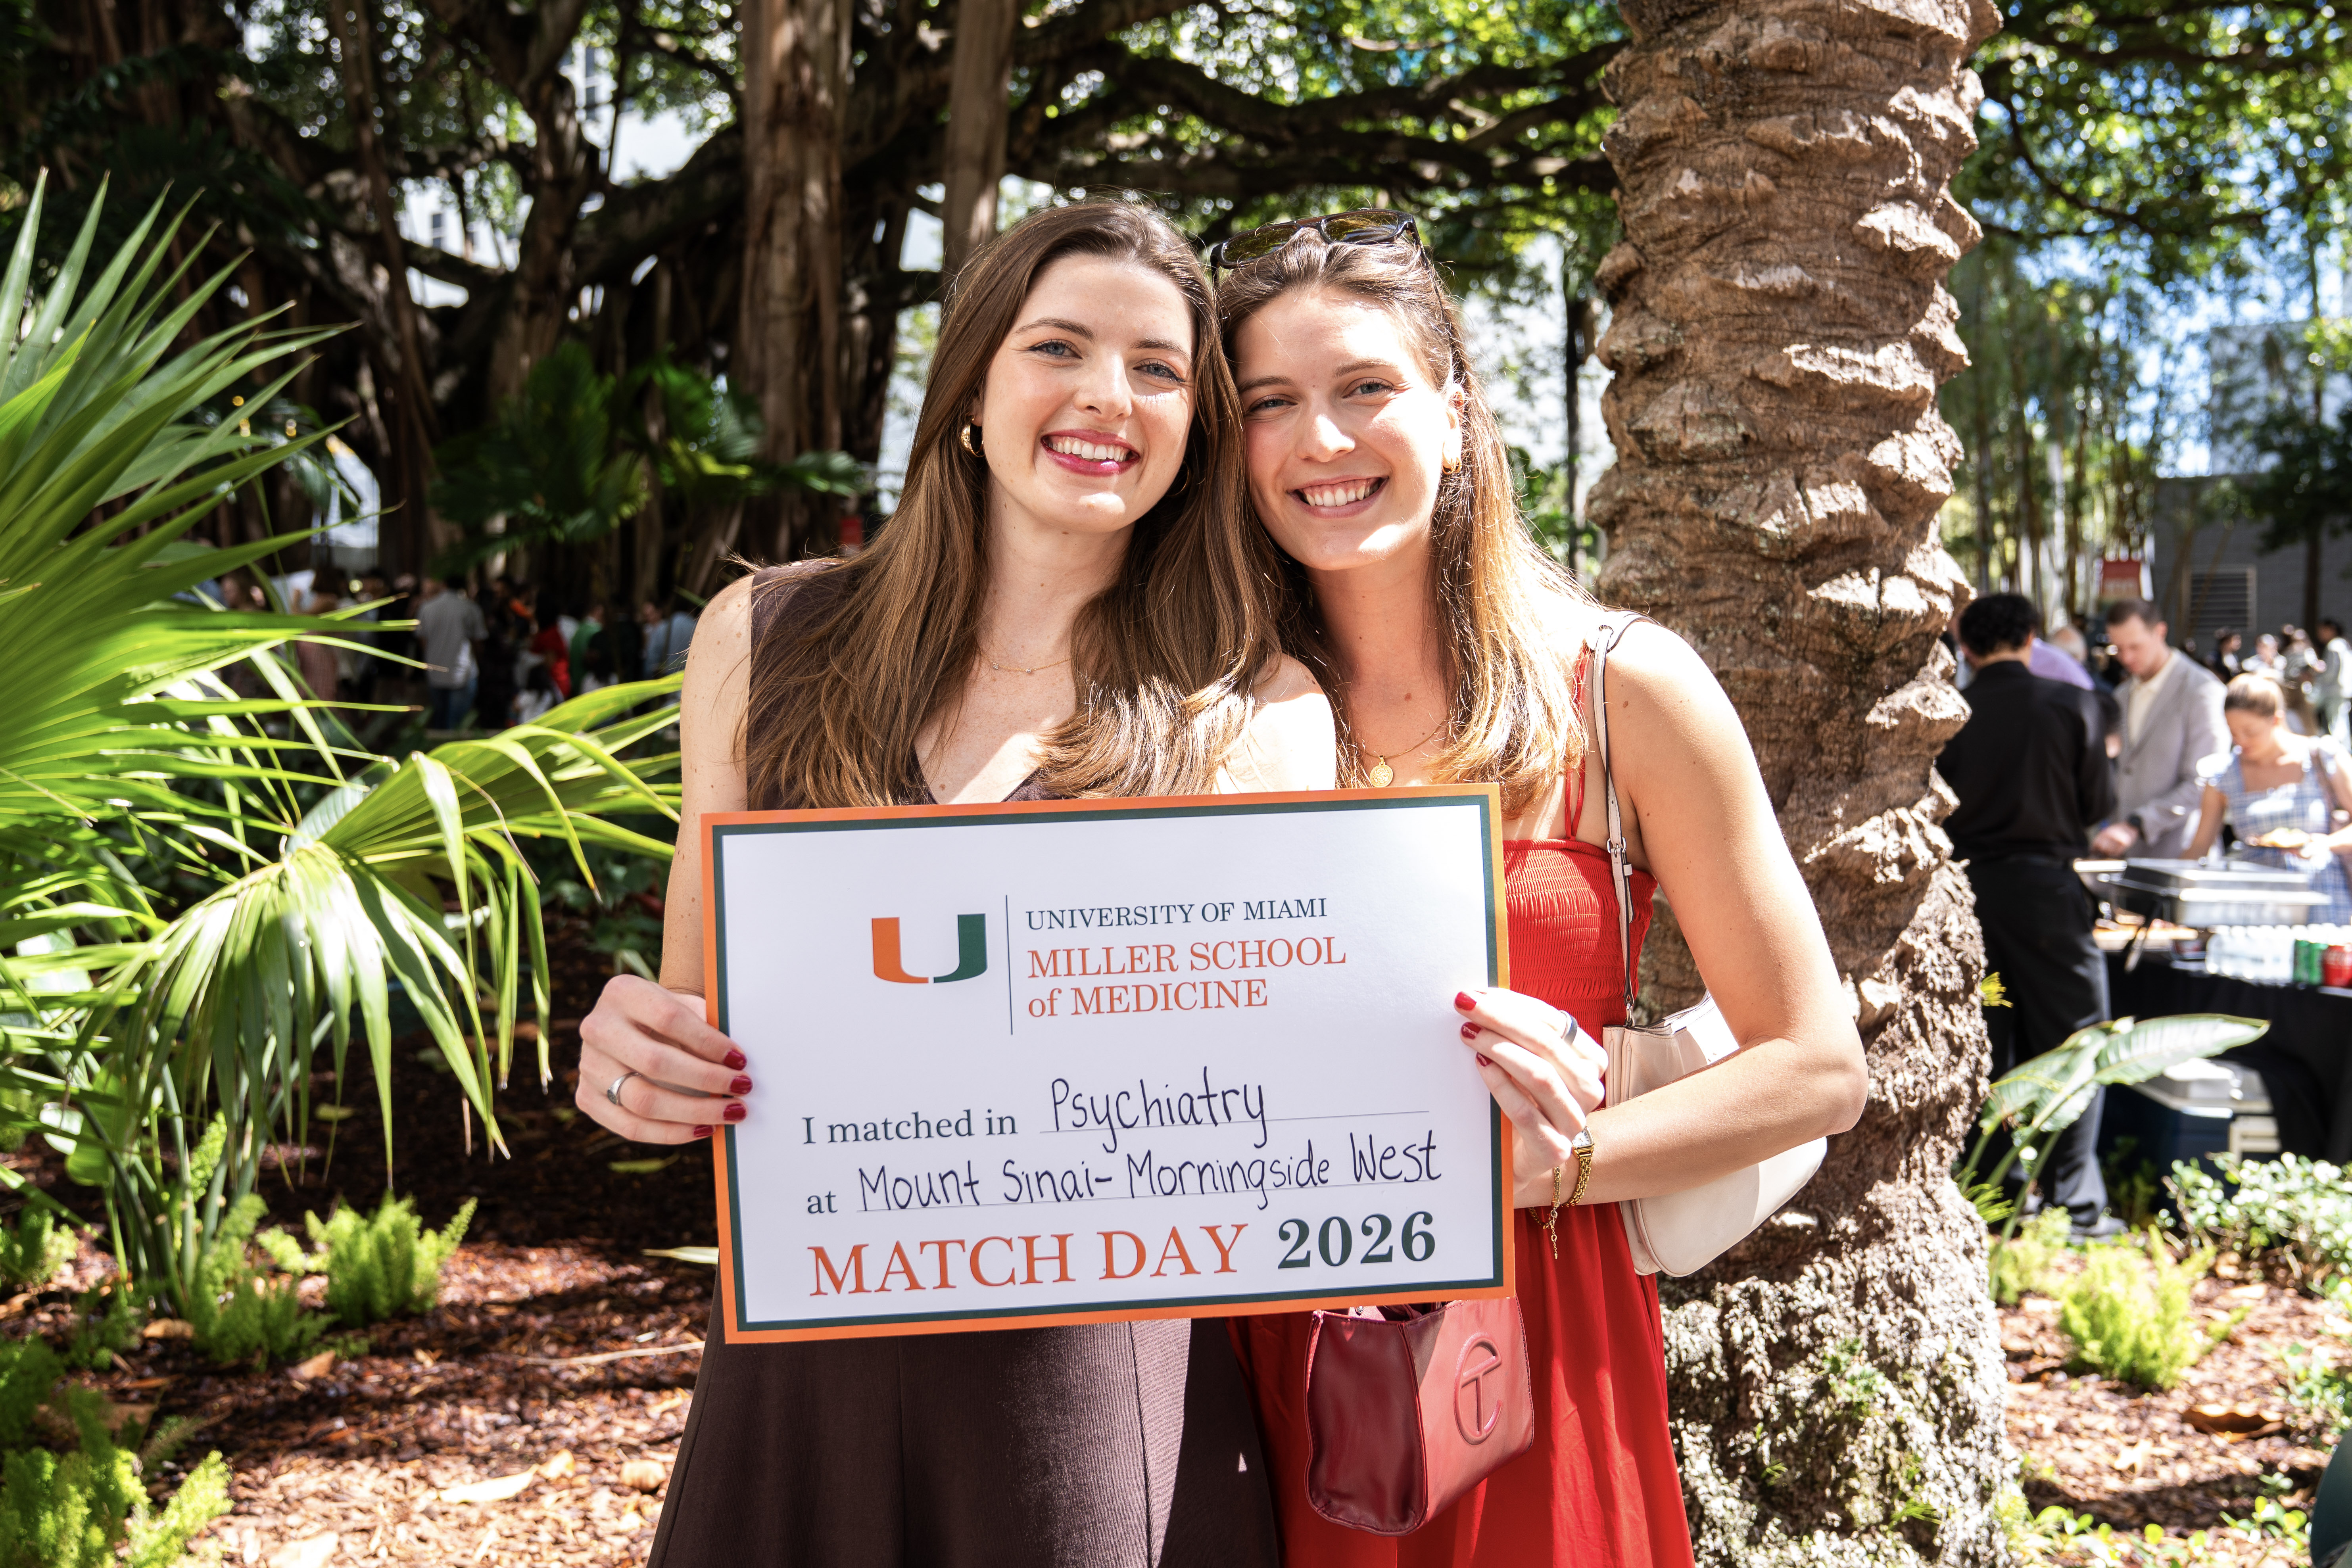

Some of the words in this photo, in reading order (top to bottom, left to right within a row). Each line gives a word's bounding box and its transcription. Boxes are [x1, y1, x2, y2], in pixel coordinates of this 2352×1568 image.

[1026, 904, 1194, 930] UNIVERSITY
[1202, 903, 1234, 922] OF
[1243, 898, 1327, 920] MIAMI
[872, 914, 987, 983] U
[1028, 944, 1178, 978] MILLER
[1190, 937, 1346, 971] SCHOOL
[1029, 988, 1062, 1017] of
[1071, 979, 1267, 1015] MEDICINE
[803, 1117, 816, 1144] I
[828, 1109, 974, 1143] matched
[986, 1109, 1017, 1135] in
[1052, 1066, 1267, 1153] Psychiatry
[859, 1161, 980, 1211] Mount
[1350, 1130, 1441, 1182] West
[808, 1191, 837, 1213] at
[807, 1234, 1075, 1296] MATCH
[1097, 1224, 1248, 1280] DAY
[1278, 1211, 1435, 1269] 2026
